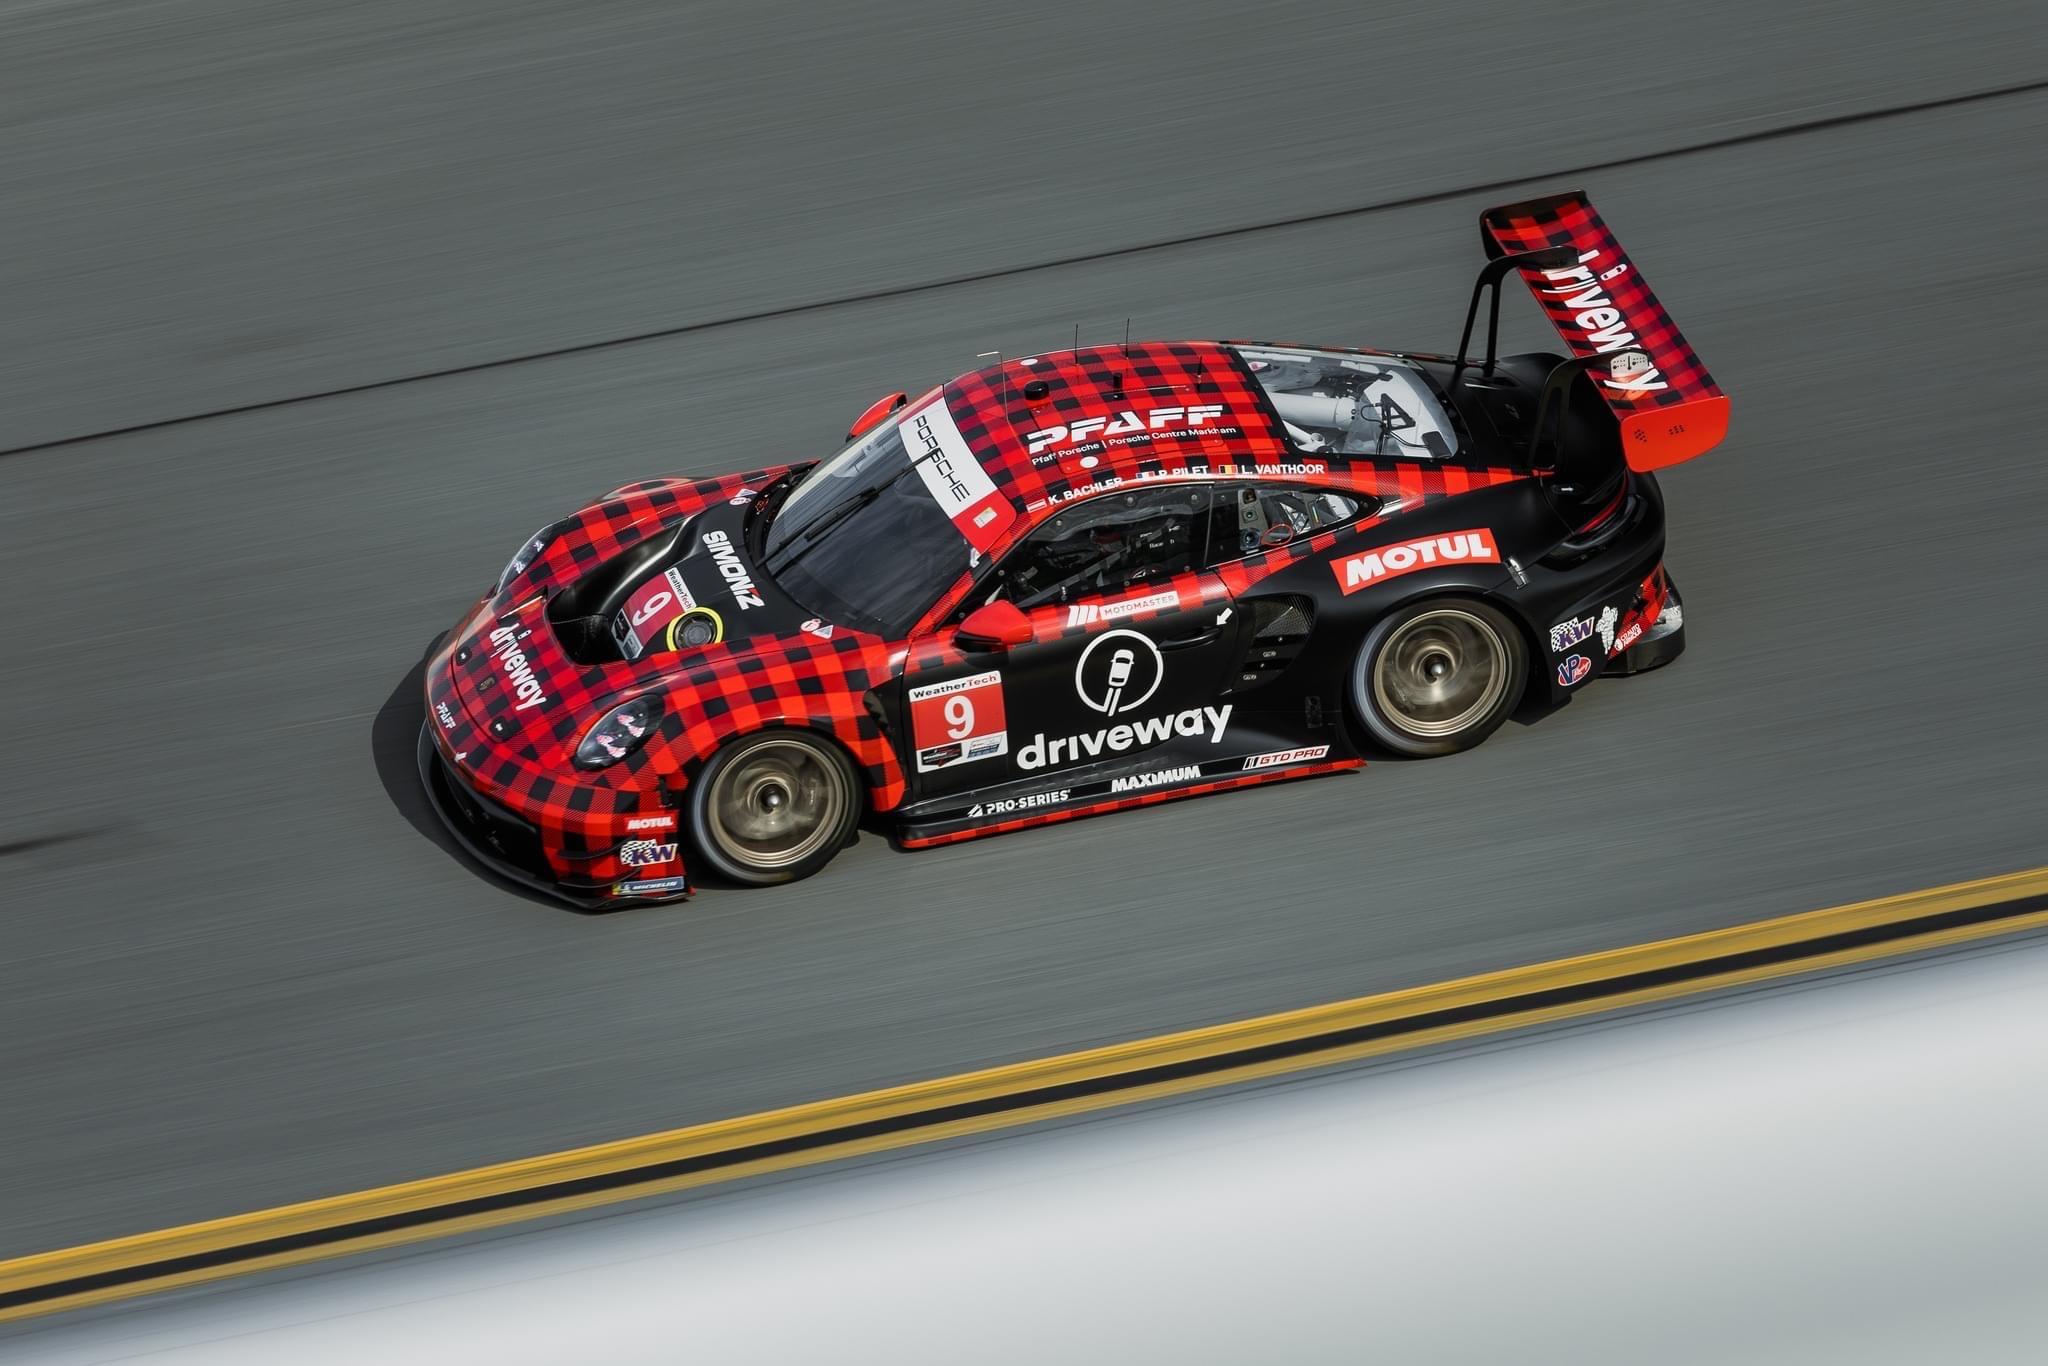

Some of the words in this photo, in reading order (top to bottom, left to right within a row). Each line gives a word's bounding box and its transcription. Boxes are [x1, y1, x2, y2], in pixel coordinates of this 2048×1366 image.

[1541, 249, 1668, 391] rivewy
[1027, 404, 1223, 454] PFAFF
[1059, 442, 1100, 458] Porsche
[1108, 434, 1150, 446] Porsche
[1151, 429, 1188, 440] Centre
[1188, 426, 1236, 437] Markham
[913, 414, 971, 502] PORSCHE
[1172, 465, 1208, 478] PILET
[1241, 465, 1253, 475] L.
[1255, 464, 1325, 475] VANTHOOR
[1048, 493, 1062, 506] K.
[1063, 476, 1123, 501] BACHLER
[702, 530, 766, 611] SIMONIZ
[1346, 533, 1492, 588] MOTUL
[667, 570, 693, 610] WeatherTech
[1104, 594, 1175, 615] MOTOMASTER
[632, 591, 673, 627] 9
[1558, 617, 1594, 651] KW
[489, 622, 547, 711] driveway
[1558, 654, 1581, 685] VP
[913, 674, 998, 699] WeatherTech
[436, 702, 456, 729] PFAFF
[944, 695, 975, 740] 9
[1016, 704, 1233, 770] driveway
[1259, 752, 1290, 765] GTD
[1293, 747, 1326, 759] PRO
[1111, 765, 1201, 792] MAXIMUM
[627, 816, 673, 830] MOTUL
[630, 844, 677, 866] KW
